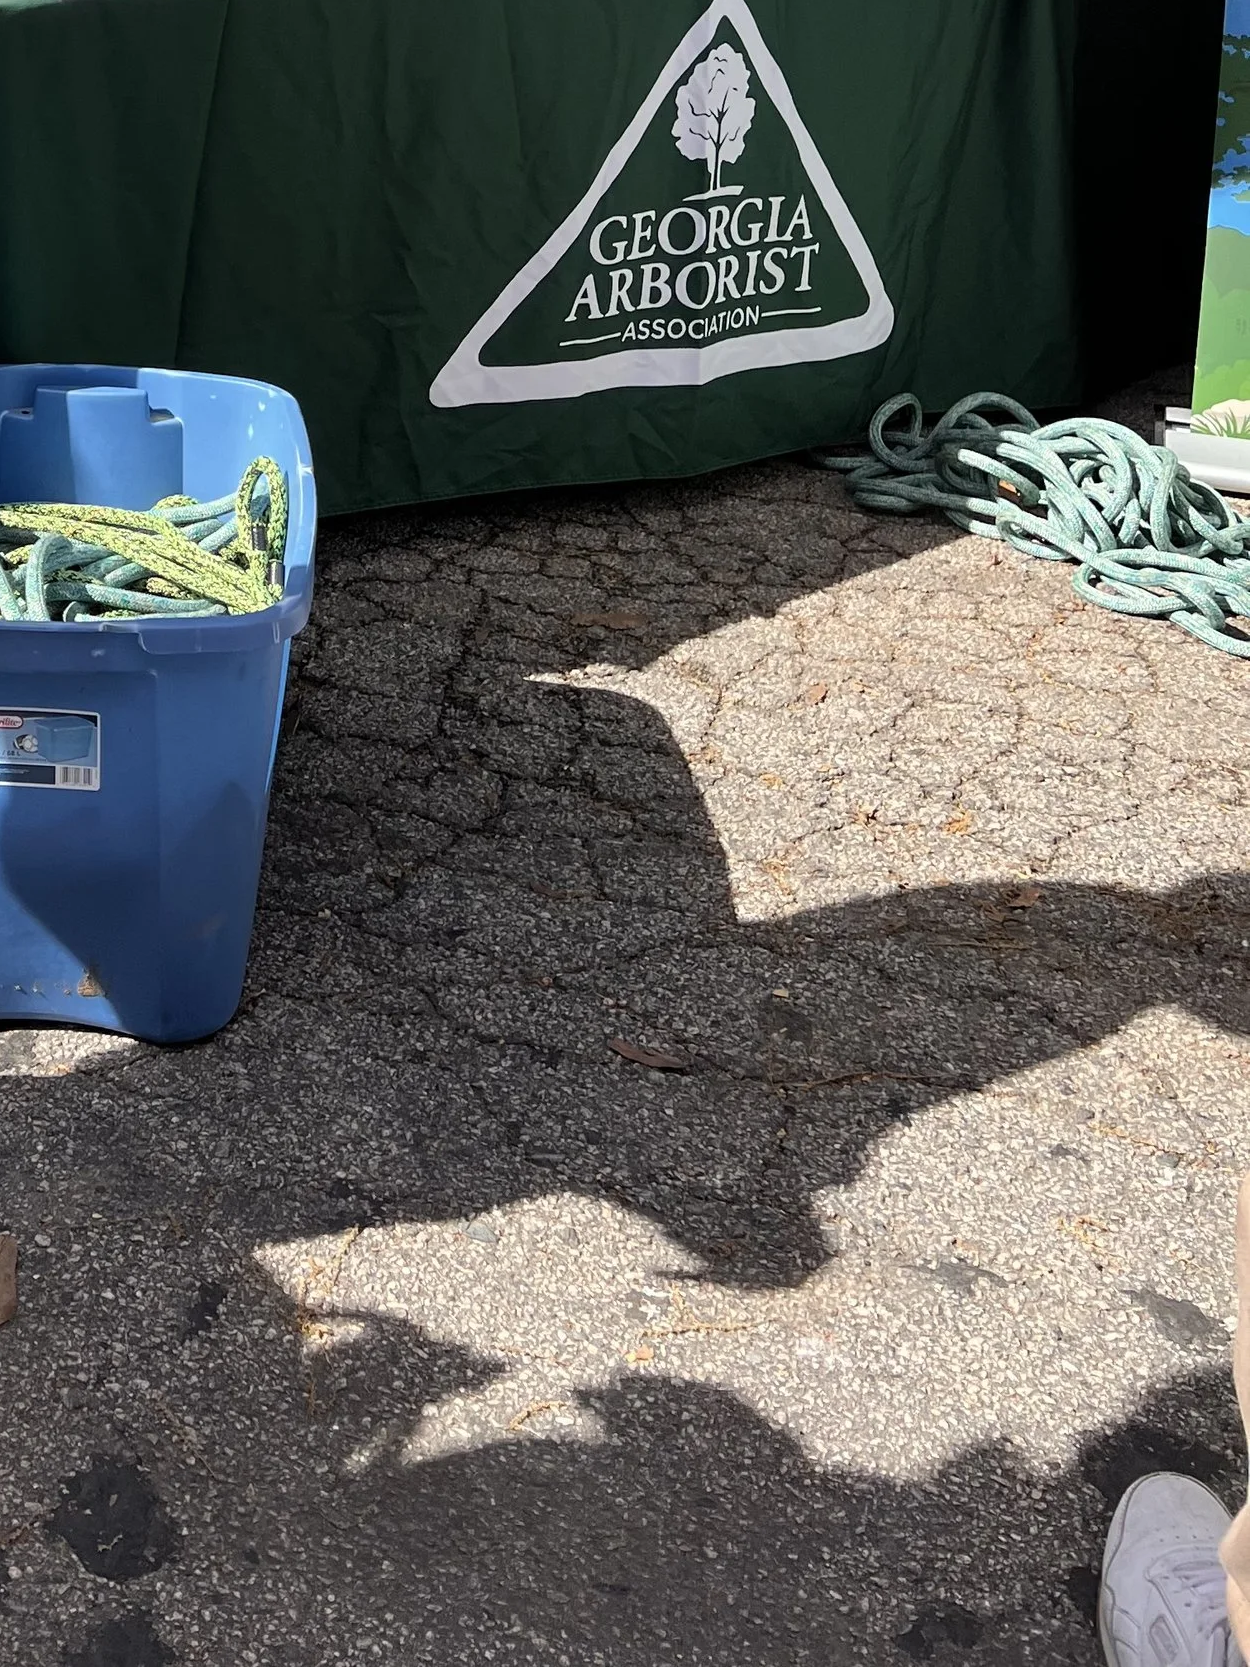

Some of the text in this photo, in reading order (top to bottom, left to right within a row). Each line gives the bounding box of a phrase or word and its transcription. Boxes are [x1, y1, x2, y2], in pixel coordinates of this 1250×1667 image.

[588, 193, 813, 266] GEORGIA
[564, 242, 820, 322] ARBORIST
[621, 305, 761, 342] ASSOCIATION
